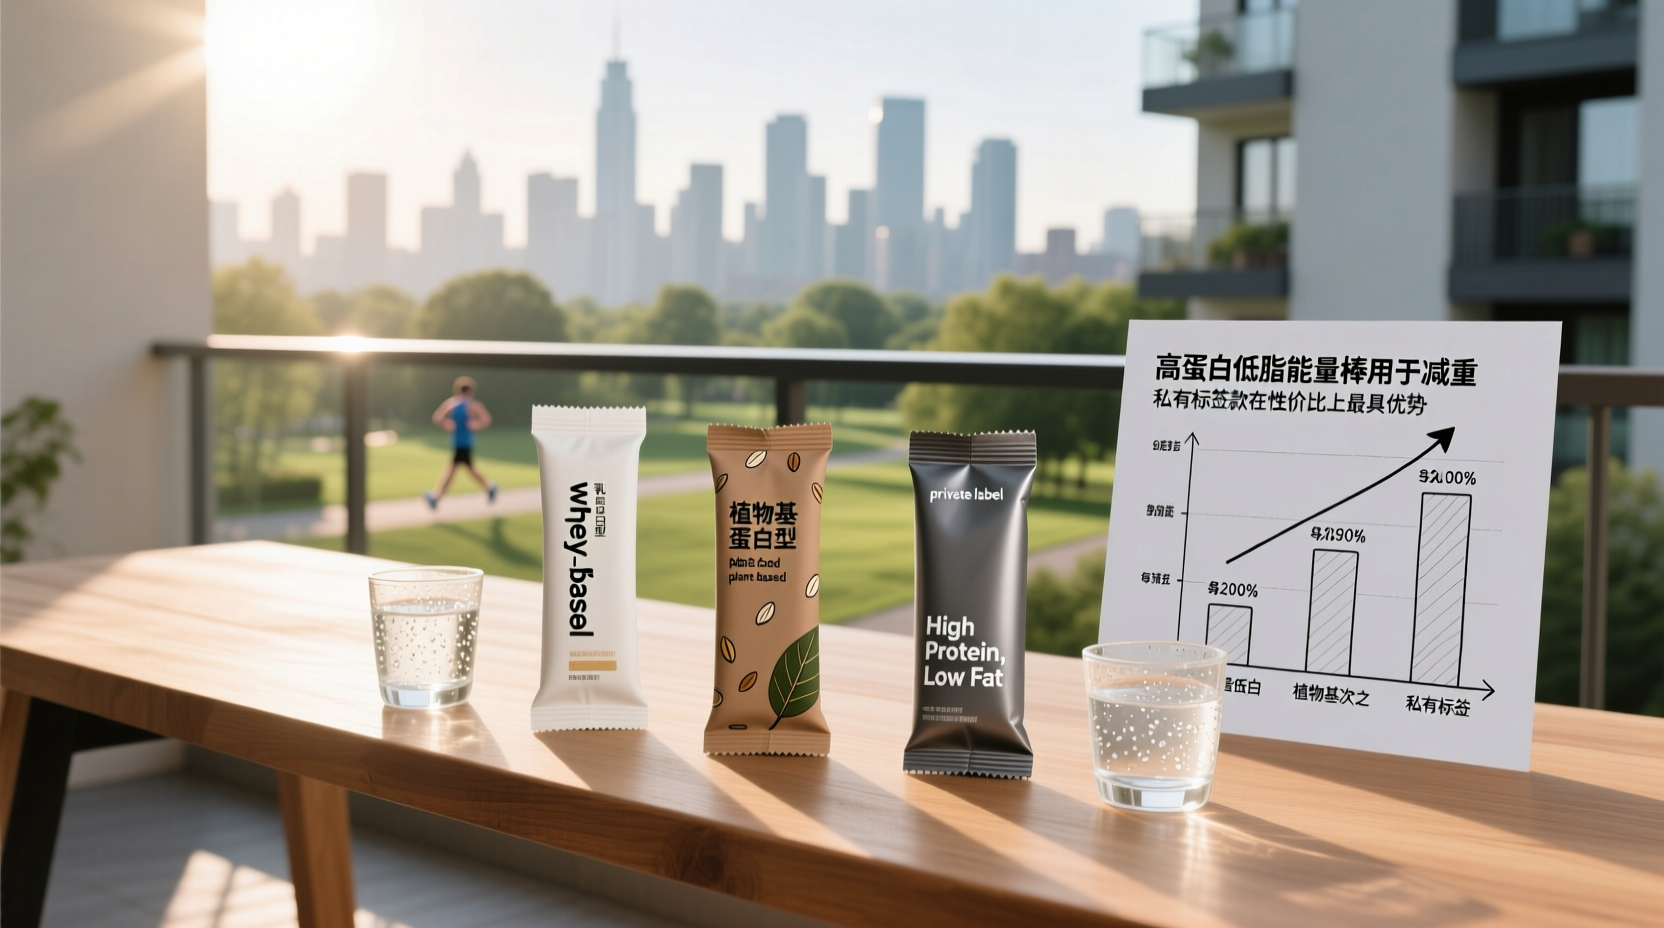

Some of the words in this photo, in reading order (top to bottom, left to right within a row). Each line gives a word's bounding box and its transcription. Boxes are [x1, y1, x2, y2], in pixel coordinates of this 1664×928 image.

[1154, 352, 1478, 387] 高蛋白低脂能量棒用于减重
[1152, 388, 1428, 416] 私有标签款在性价比上最具优势
[974, 487, 1004, 501] label
[729, 500, 799, 525] 植物基
[728, 526, 797, 550] 蛋白型
[926, 615, 975, 642] High
[925, 641, 1006, 666] Protein,
[924, 665, 966, 687] Low
[970, 666, 1004, 688] Fat
[1292, 682, 1371, 708] 植物基次之
[1405, 694, 1472, 718] 私有标签
